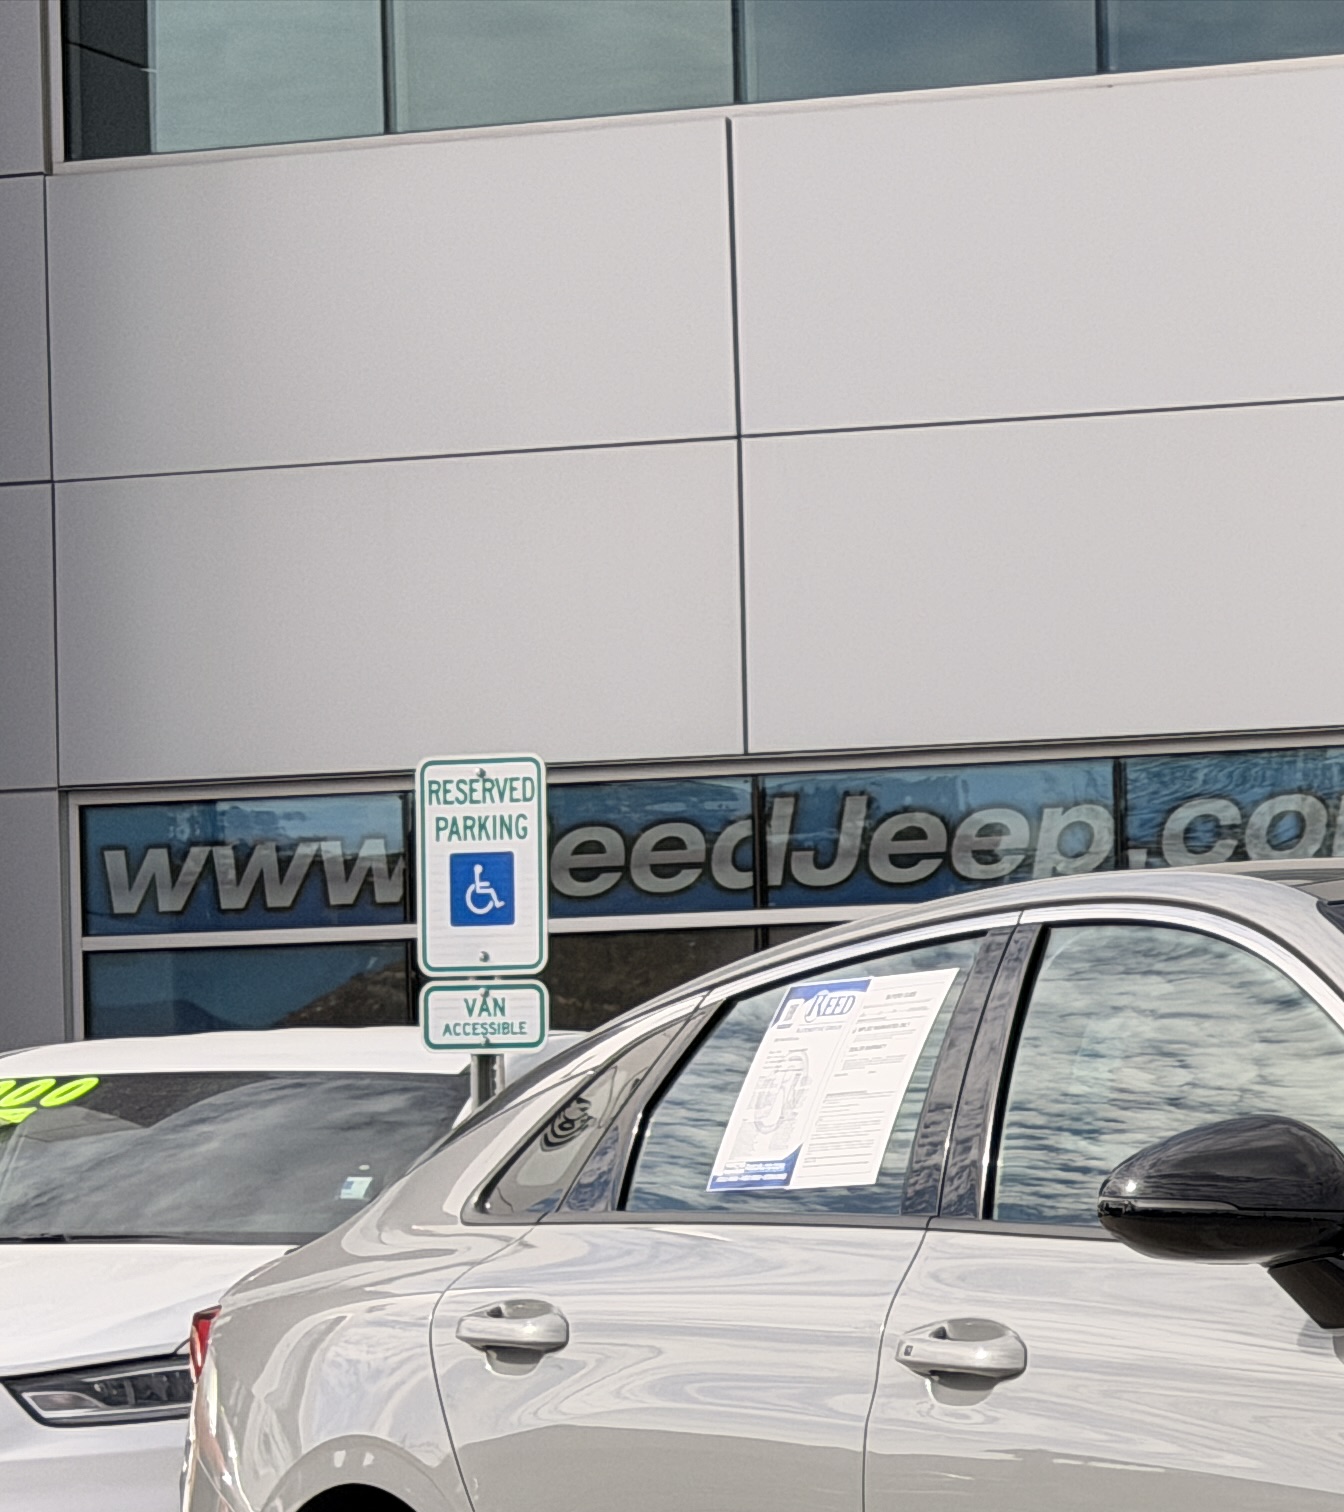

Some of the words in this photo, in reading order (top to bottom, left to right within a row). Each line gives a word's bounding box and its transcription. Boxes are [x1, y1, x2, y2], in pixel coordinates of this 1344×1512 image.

[428, 776, 535, 805] RESERVED
[435, 813, 528, 842] PARKING
[464, 997, 506, 1017] VAN
[804, 994, 857, 1023] REED
[442, 1021, 528, 1037] ACCESSIBLE
[0, 1077, 99, 1108] 00
